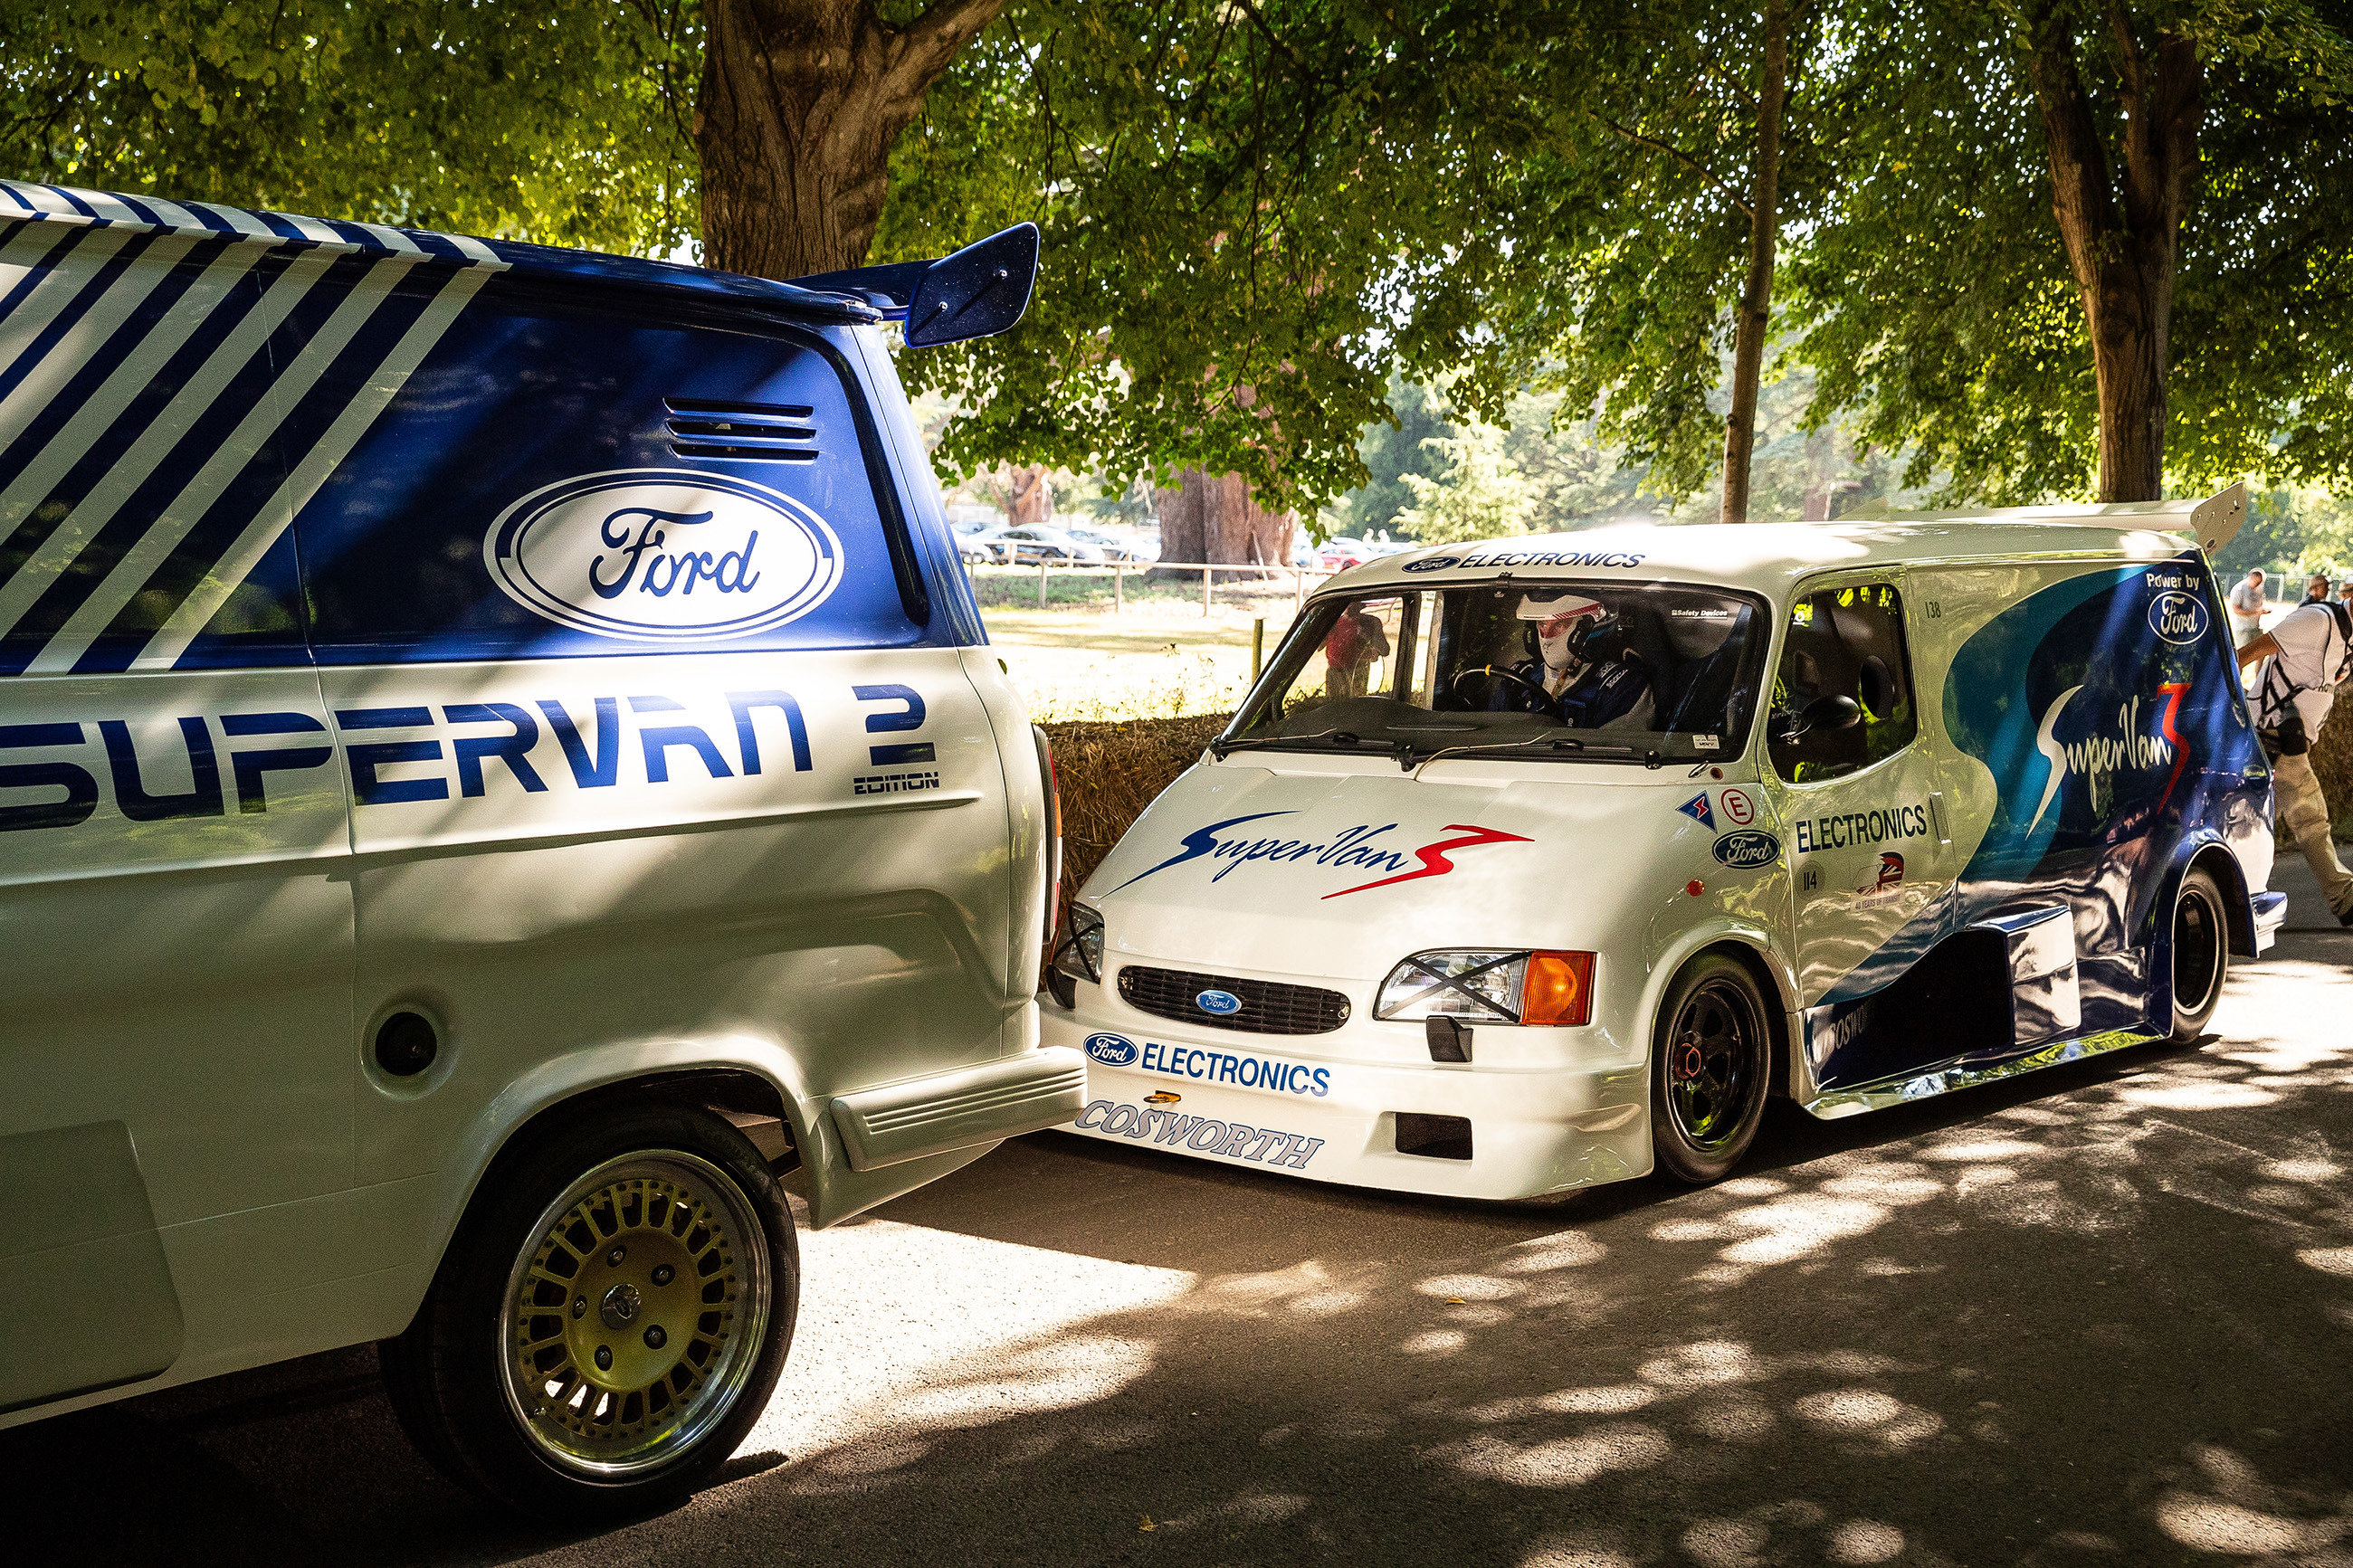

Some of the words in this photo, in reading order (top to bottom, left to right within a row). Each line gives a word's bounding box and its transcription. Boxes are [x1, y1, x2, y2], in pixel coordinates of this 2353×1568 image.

[588, 507, 760, 600] Ford
[1411, 557, 1452, 571] Ford
[1457, 552, 1646, 569] ELECTRONICS
[2146, 573, 2182, 589] Power
[2185, 574, 2200, 591] by
[1677, 609, 1700, 617] Safety
[1700, 609, 1728, 617] Devices
[1925, 601, 1941, 619] 138
[2160, 595, 2198, 635] Ford
[0, 690, 814, 832] SUPERVAN
[852, 684, 937, 766] 2
[853, 772, 939, 796] EDITION
[1728, 796, 1748, 817] E
[1796, 804, 1928, 854] ELECTRONICS
[1726, 836, 1770, 862] Ford
[1803, 870, 1818, 891] 114
[1205, 993, 1231, 1010] Ford
[1091, 1037, 1128, 1063] Ford
[1140, 1042, 1331, 1098] ELECTRONICS
[1074, 1099, 1325, 1170] COSWORTH
